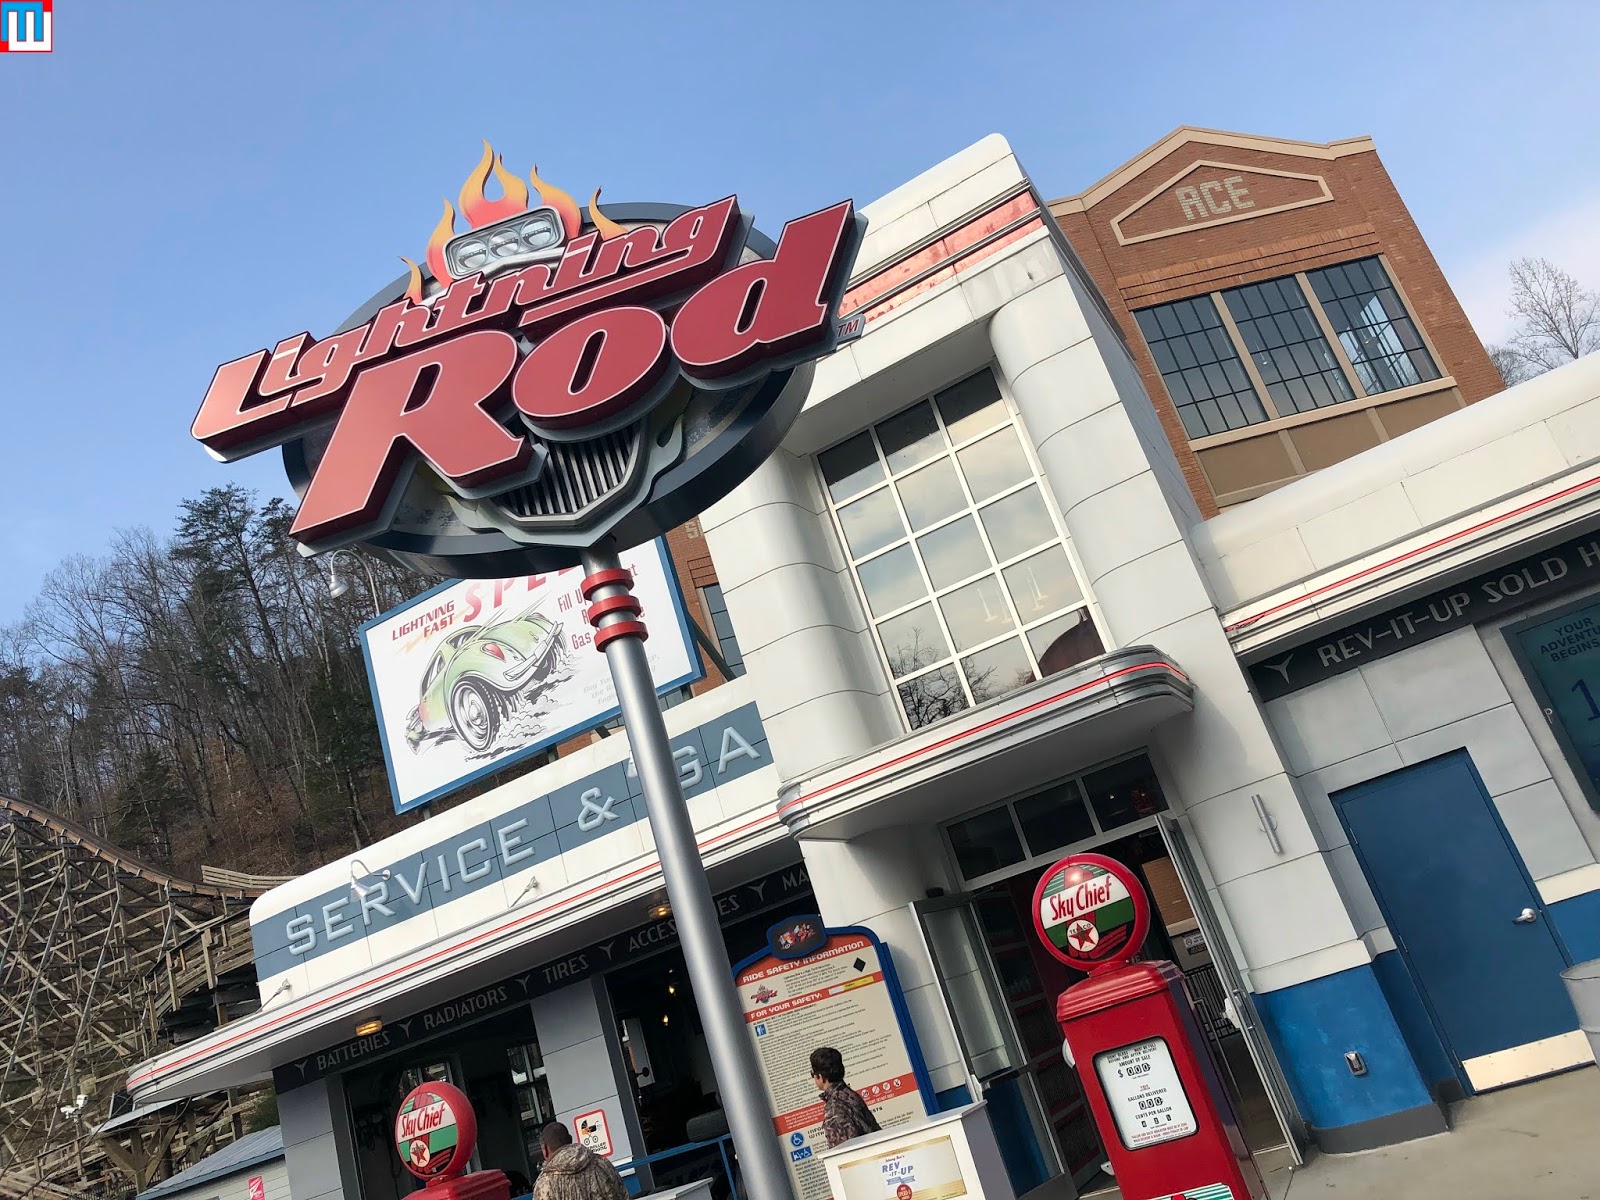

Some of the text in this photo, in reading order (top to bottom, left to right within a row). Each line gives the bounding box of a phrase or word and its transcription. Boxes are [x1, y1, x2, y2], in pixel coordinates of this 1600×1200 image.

[1175, 175, 1256, 221] ACE
[190, 193, 739, 442] Lightning
[837, 318, 860, 338] TM
[287, 198, 855, 538] Rod
[392, 599, 456, 641] LIGHTNING
[557, 592, 573, 613] Fill
[1317, 591, 1471, 668] REV-IT-UP
[1480, 557, 1569, 604] SOLD
[423, 612, 455, 638] FAST
[571, 632, 592, 650] Gas
[1554, 617, 1594, 636] YOUR
[286, 817, 536, 957] SERVICE
[577, 786, 621, 832] &
[1049, 875, 1113, 921] Sky Chief
[742, 971, 765, 983] RIDE
[766, 960, 801, 976] SAFETY
[802, 940, 864, 965] INFORMATION
[316, 1029, 391, 1072] BATTERIES
[423, 985, 508, 1030] RADIATORS
[542, 953, 589, 985] TIRES
[750, 1009, 768, 1020] FOR
[768, 1002, 791, 1014] YOUR
[792, 992, 823, 1007] SAFETY:
[1117, 1069, 1124, 1078] $
[401, 1102, 446, 1138] Sky Chief
[882, 1161, 900, 1174] REV
[901, 1165, 914, 1175] UP
